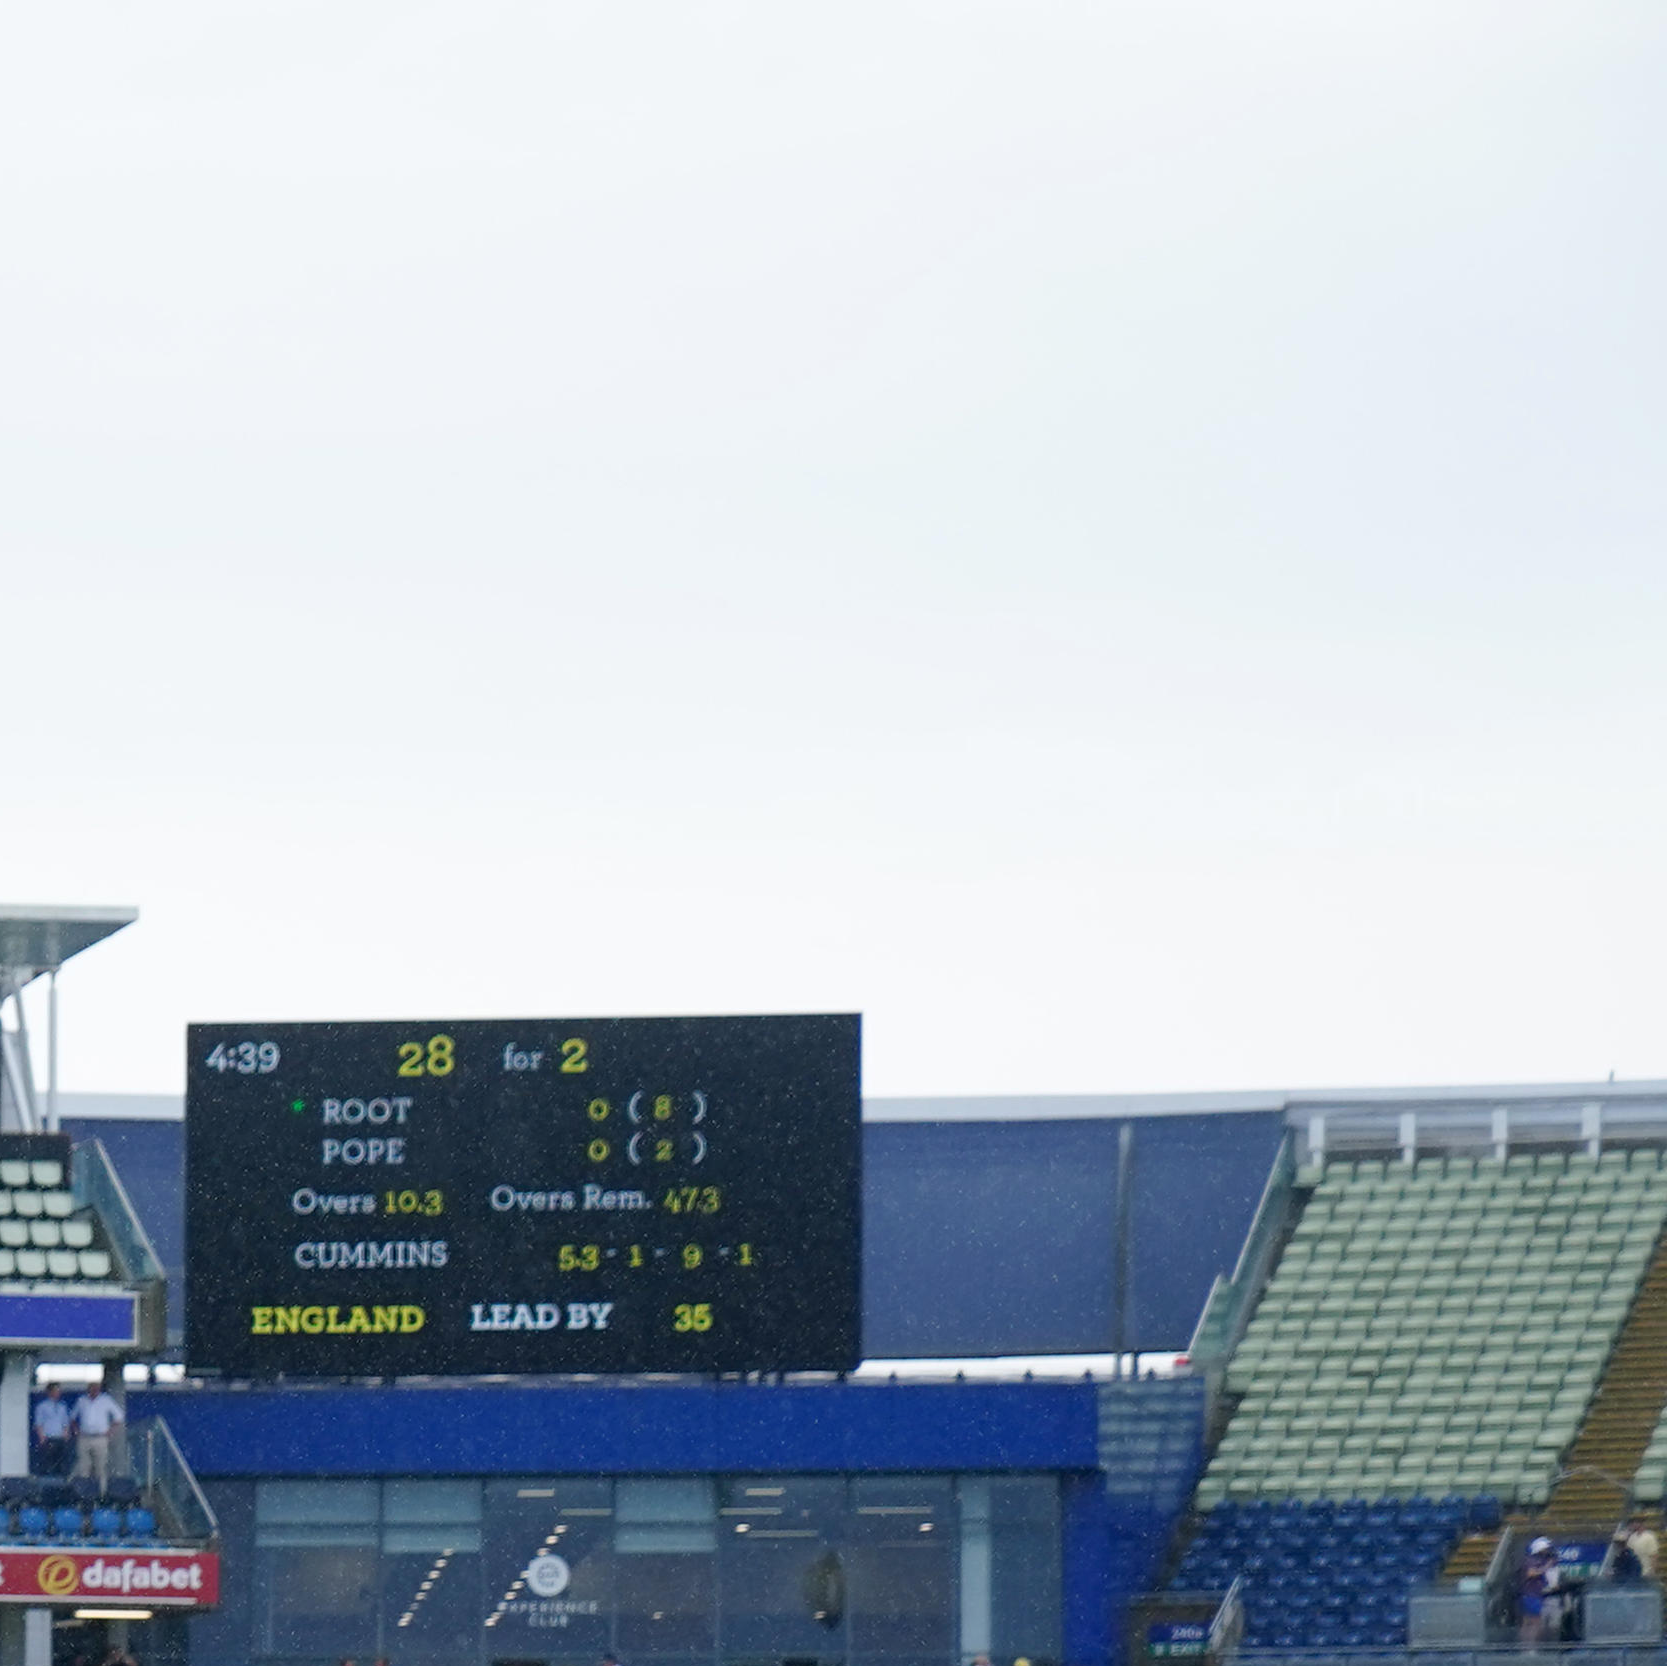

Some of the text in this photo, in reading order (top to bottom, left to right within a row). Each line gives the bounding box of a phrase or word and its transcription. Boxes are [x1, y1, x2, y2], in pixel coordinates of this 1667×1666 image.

[206, 1041, 281, 1073] 4:39
[398, 1035, 588, 1077] 28 for 2
[323, 1098, 412, 1124] ROOT
[323, 1138, 405, 1165] POPE
[292, 1187, 376, 1216] Overs
[384, 1190, 443, 1216] 10.3
[490, 1184, 573, 1213] Overs
[582, 1184, 650, 1212] Rem.
[293, 1242, 448, 1270] CUMMINS
[251, 1303, 713, 1335] ENGLAND LEAD BY 35
[83, 1559, 201, 1592] dafabet
